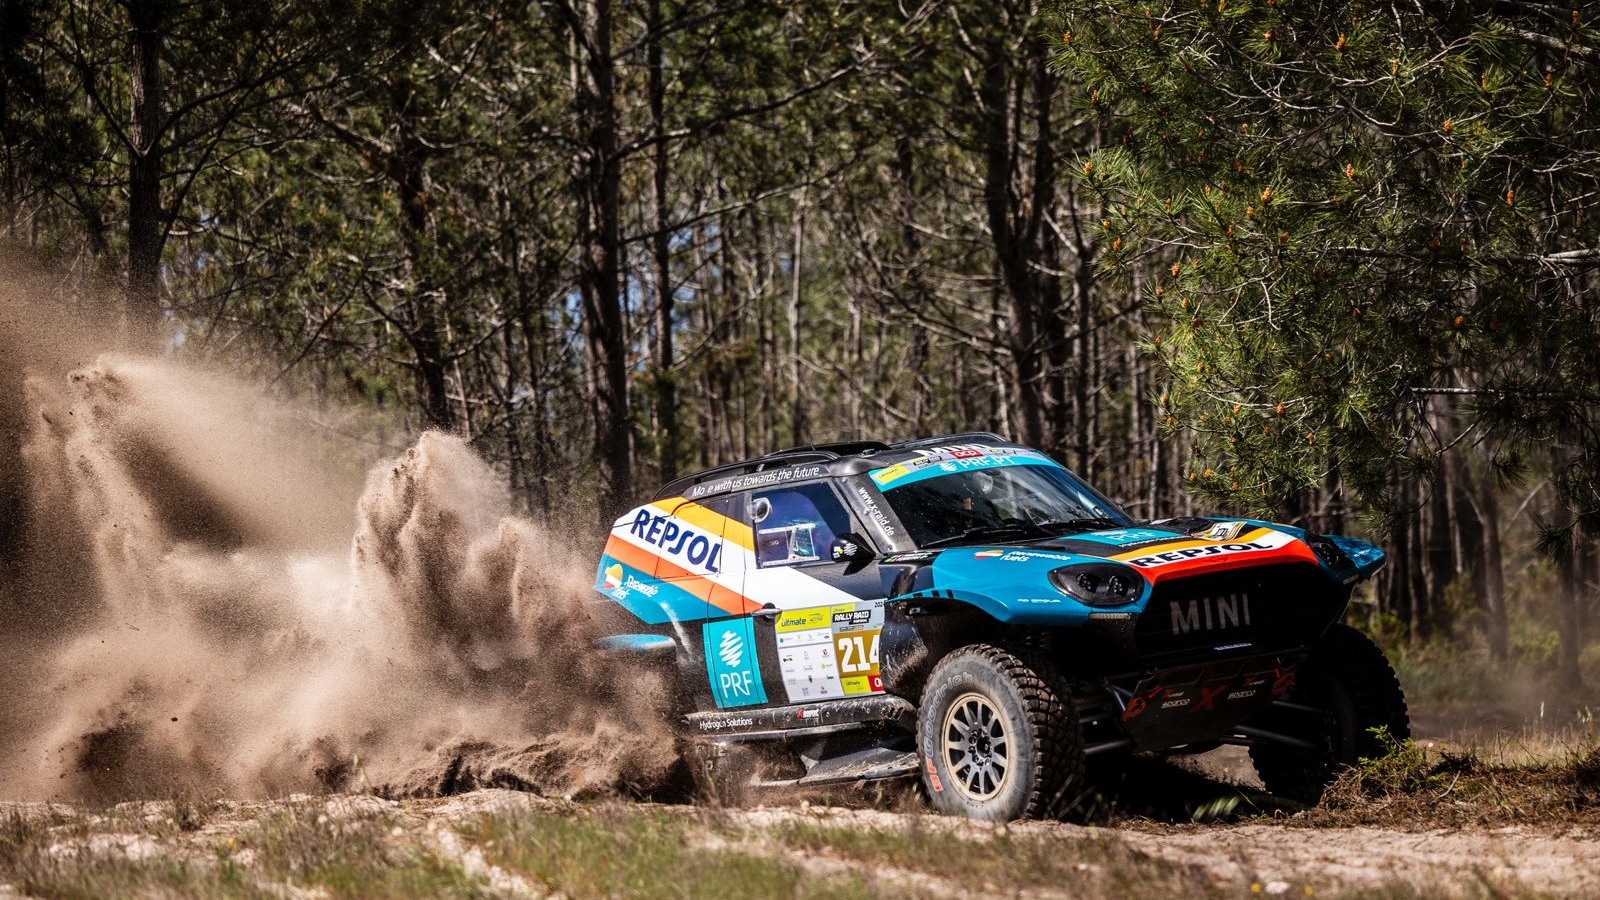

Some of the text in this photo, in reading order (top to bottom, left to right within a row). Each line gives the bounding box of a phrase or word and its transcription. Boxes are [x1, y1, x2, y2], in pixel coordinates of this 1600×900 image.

[692, 466, 819, 497] Moe with us towards the future
[859, 487, 894, 536] www.x-raid.de
[632, 508, 721, 574] REPSOL
[1130, 543, 1272, 567] REPSOL
[834, 613, 853, 622] RALLY
[1170, 593, 1251, 635] MINI
[838, 634, 880, 673] 214
[720, 670, 753, 699] PRF
[727, 718, 753, 727] Solutions
